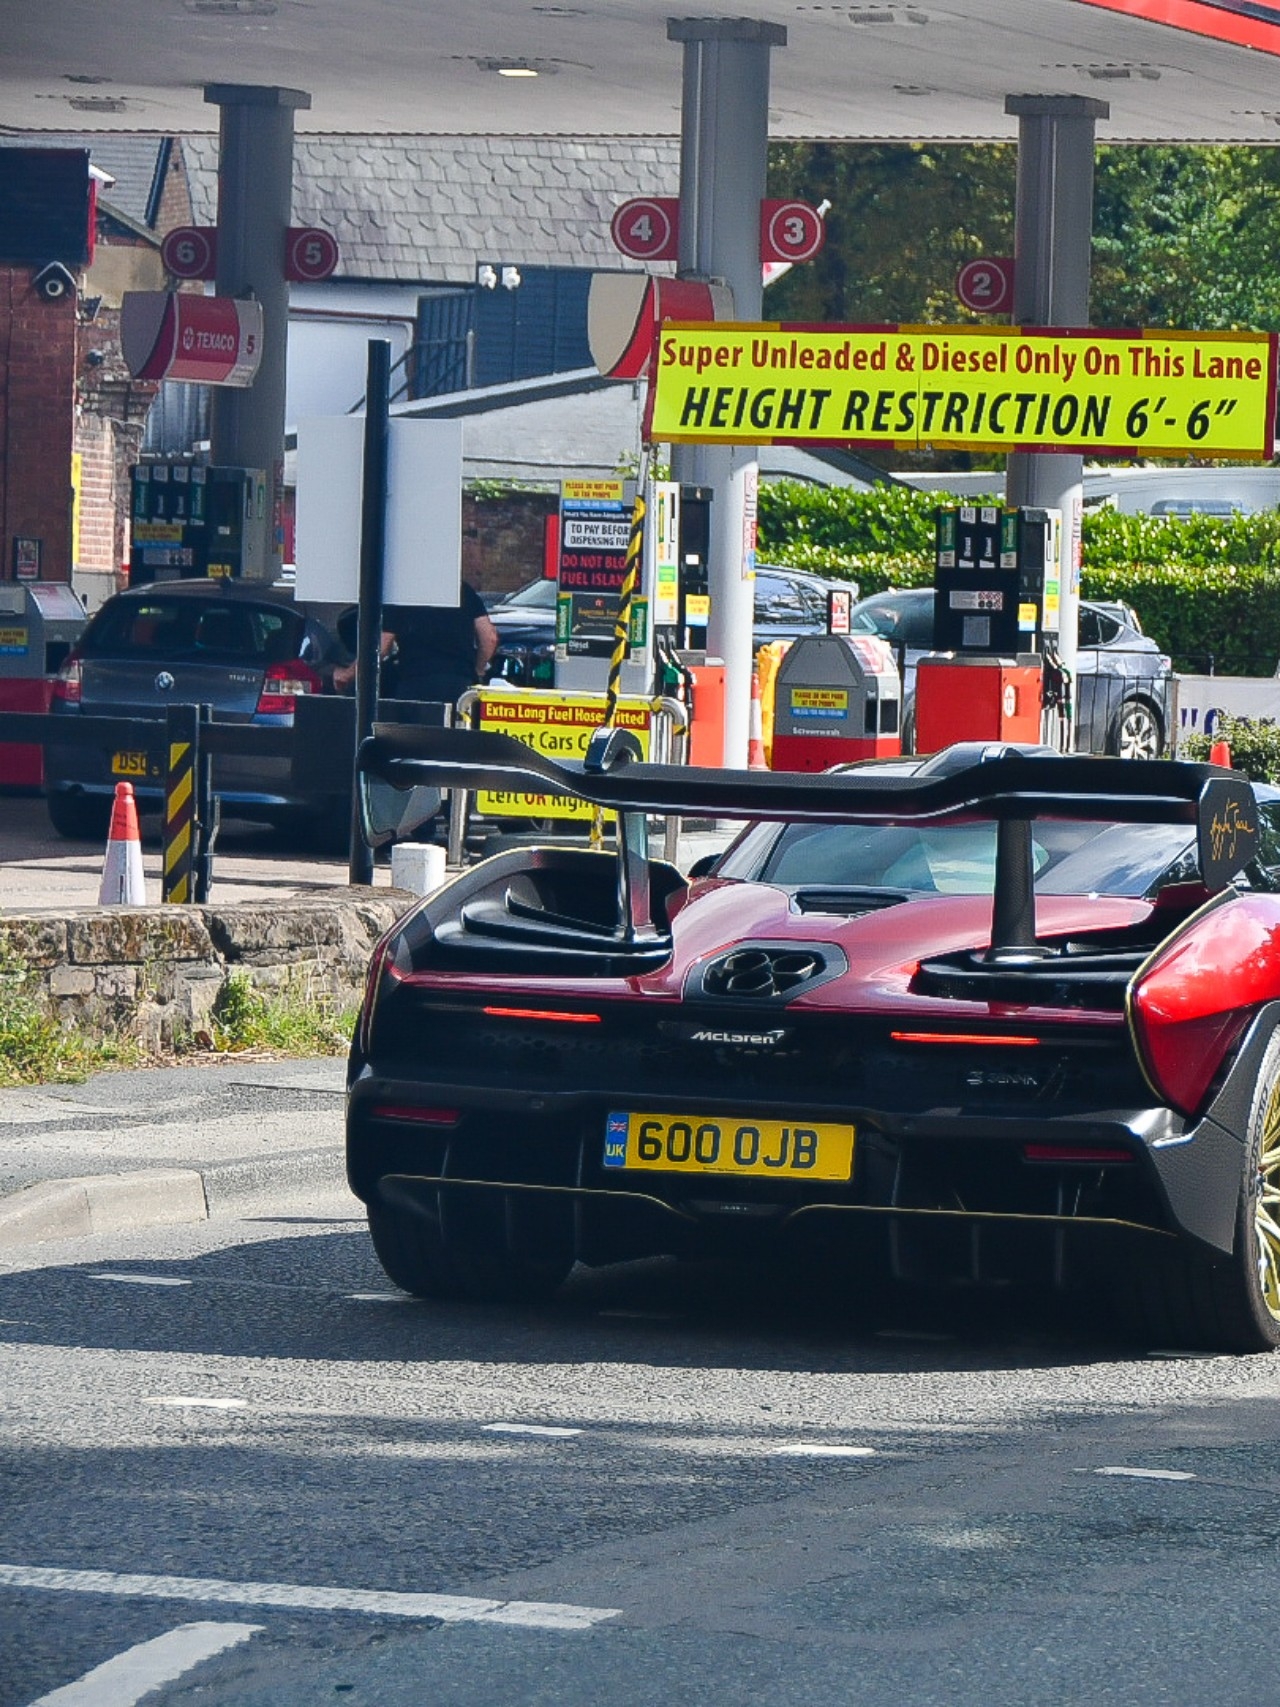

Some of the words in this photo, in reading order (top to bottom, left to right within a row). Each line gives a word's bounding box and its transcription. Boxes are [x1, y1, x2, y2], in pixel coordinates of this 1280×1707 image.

[629, 214, 652, 242] 4
[784, 216, 804, 244] 3
[176, 241, 195, 265] 6
[304, 242, 322, 265] 5
[971, 276, 991, 296] 2
[196, 332, 235, 351] TEXACO
[246, 334, 255, 355] 5
[662, 338, 743, 375] Super
[751, 339, 887, 372] Unleaded
[895, 342, 915, 372] &
[922, 341, 1007, 373] Diesel
[1016, 343, 1077, 383] Only
[1084, 345, 1120, 376] On
[1128, 346, 1185, 378] This
[1193, 348, 1262, 380] Lane
[679, 386, 832, 430] HEIGHT
[842, 388, 1112, 438] RESTRICTION
[571, 524, 582, 534] TO
[584, 524, 599, 535] PAY
[601, 524, 630, 535] BEFOR
[561, 555, 578, 567] DO
[580, 555, 603, 568] NOT
[561, 571, 588, 585] FUEL
[486, 703, 515, 719] Extra
[518, 704, 546, 723] Long
[548, 706, 572, 722] Fuel
[615, 711, 645, 725] itted
[540, 731, 573, 751] Cars
[690, 1031, 775, 1044] McLaren
[607, 1144, 624, 1158] UK
[638, 1121, 721, 1164] 600
